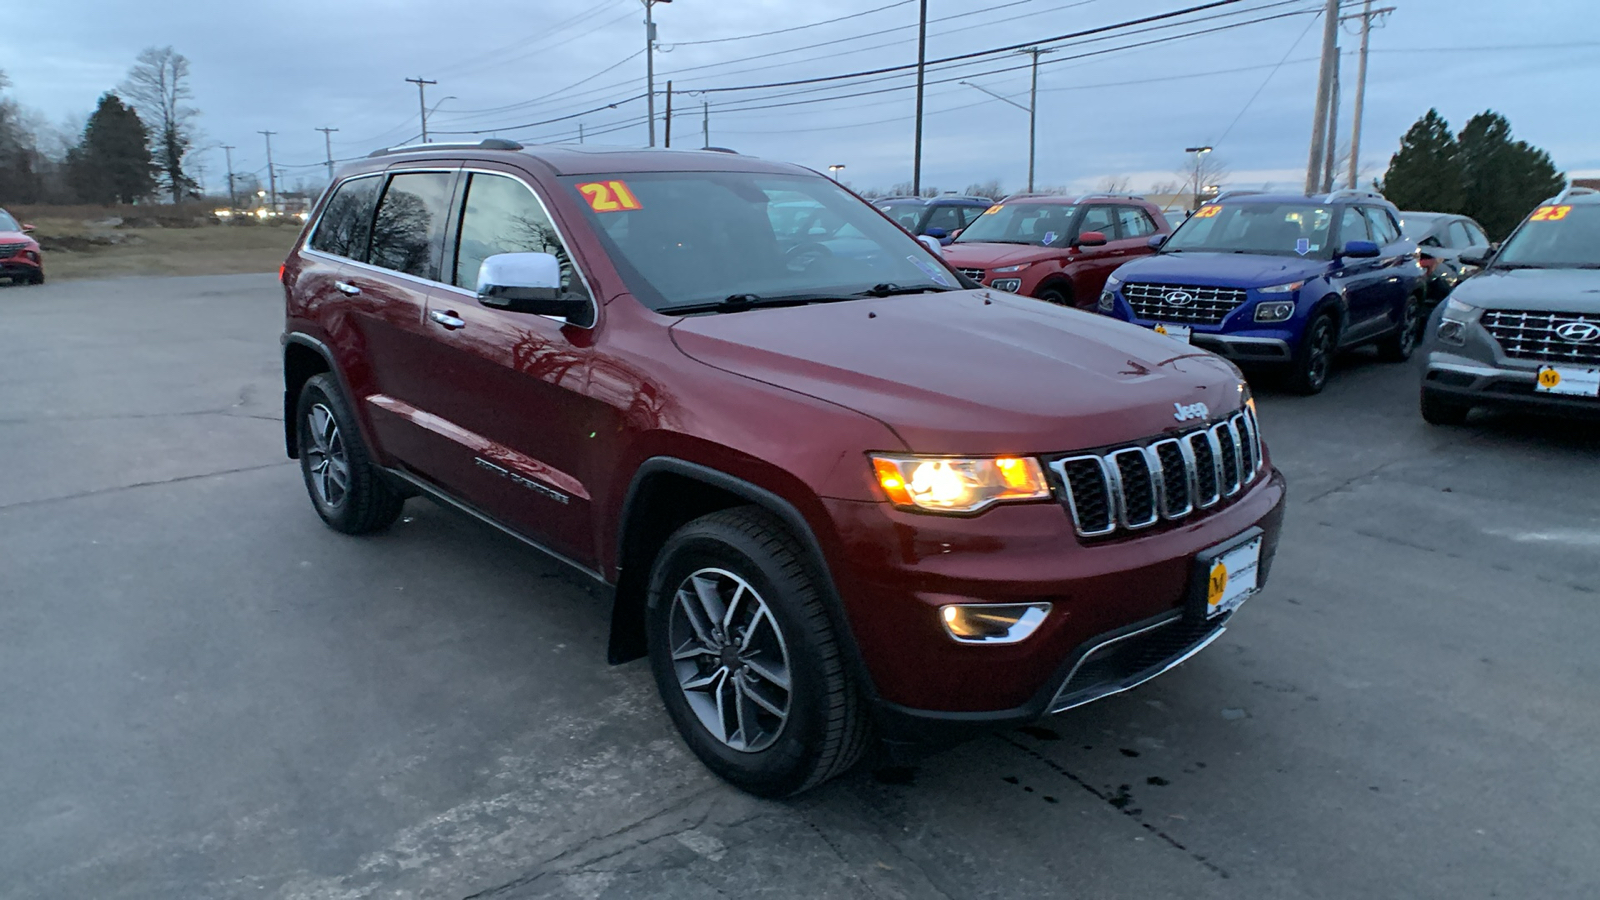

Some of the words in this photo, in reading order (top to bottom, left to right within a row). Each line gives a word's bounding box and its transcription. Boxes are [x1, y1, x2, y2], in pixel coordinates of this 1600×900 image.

[580, 181, 634, 210] 21
[1529, 205, 1571, 220] 23
[1173, 402, 1209, 421] Jeep
